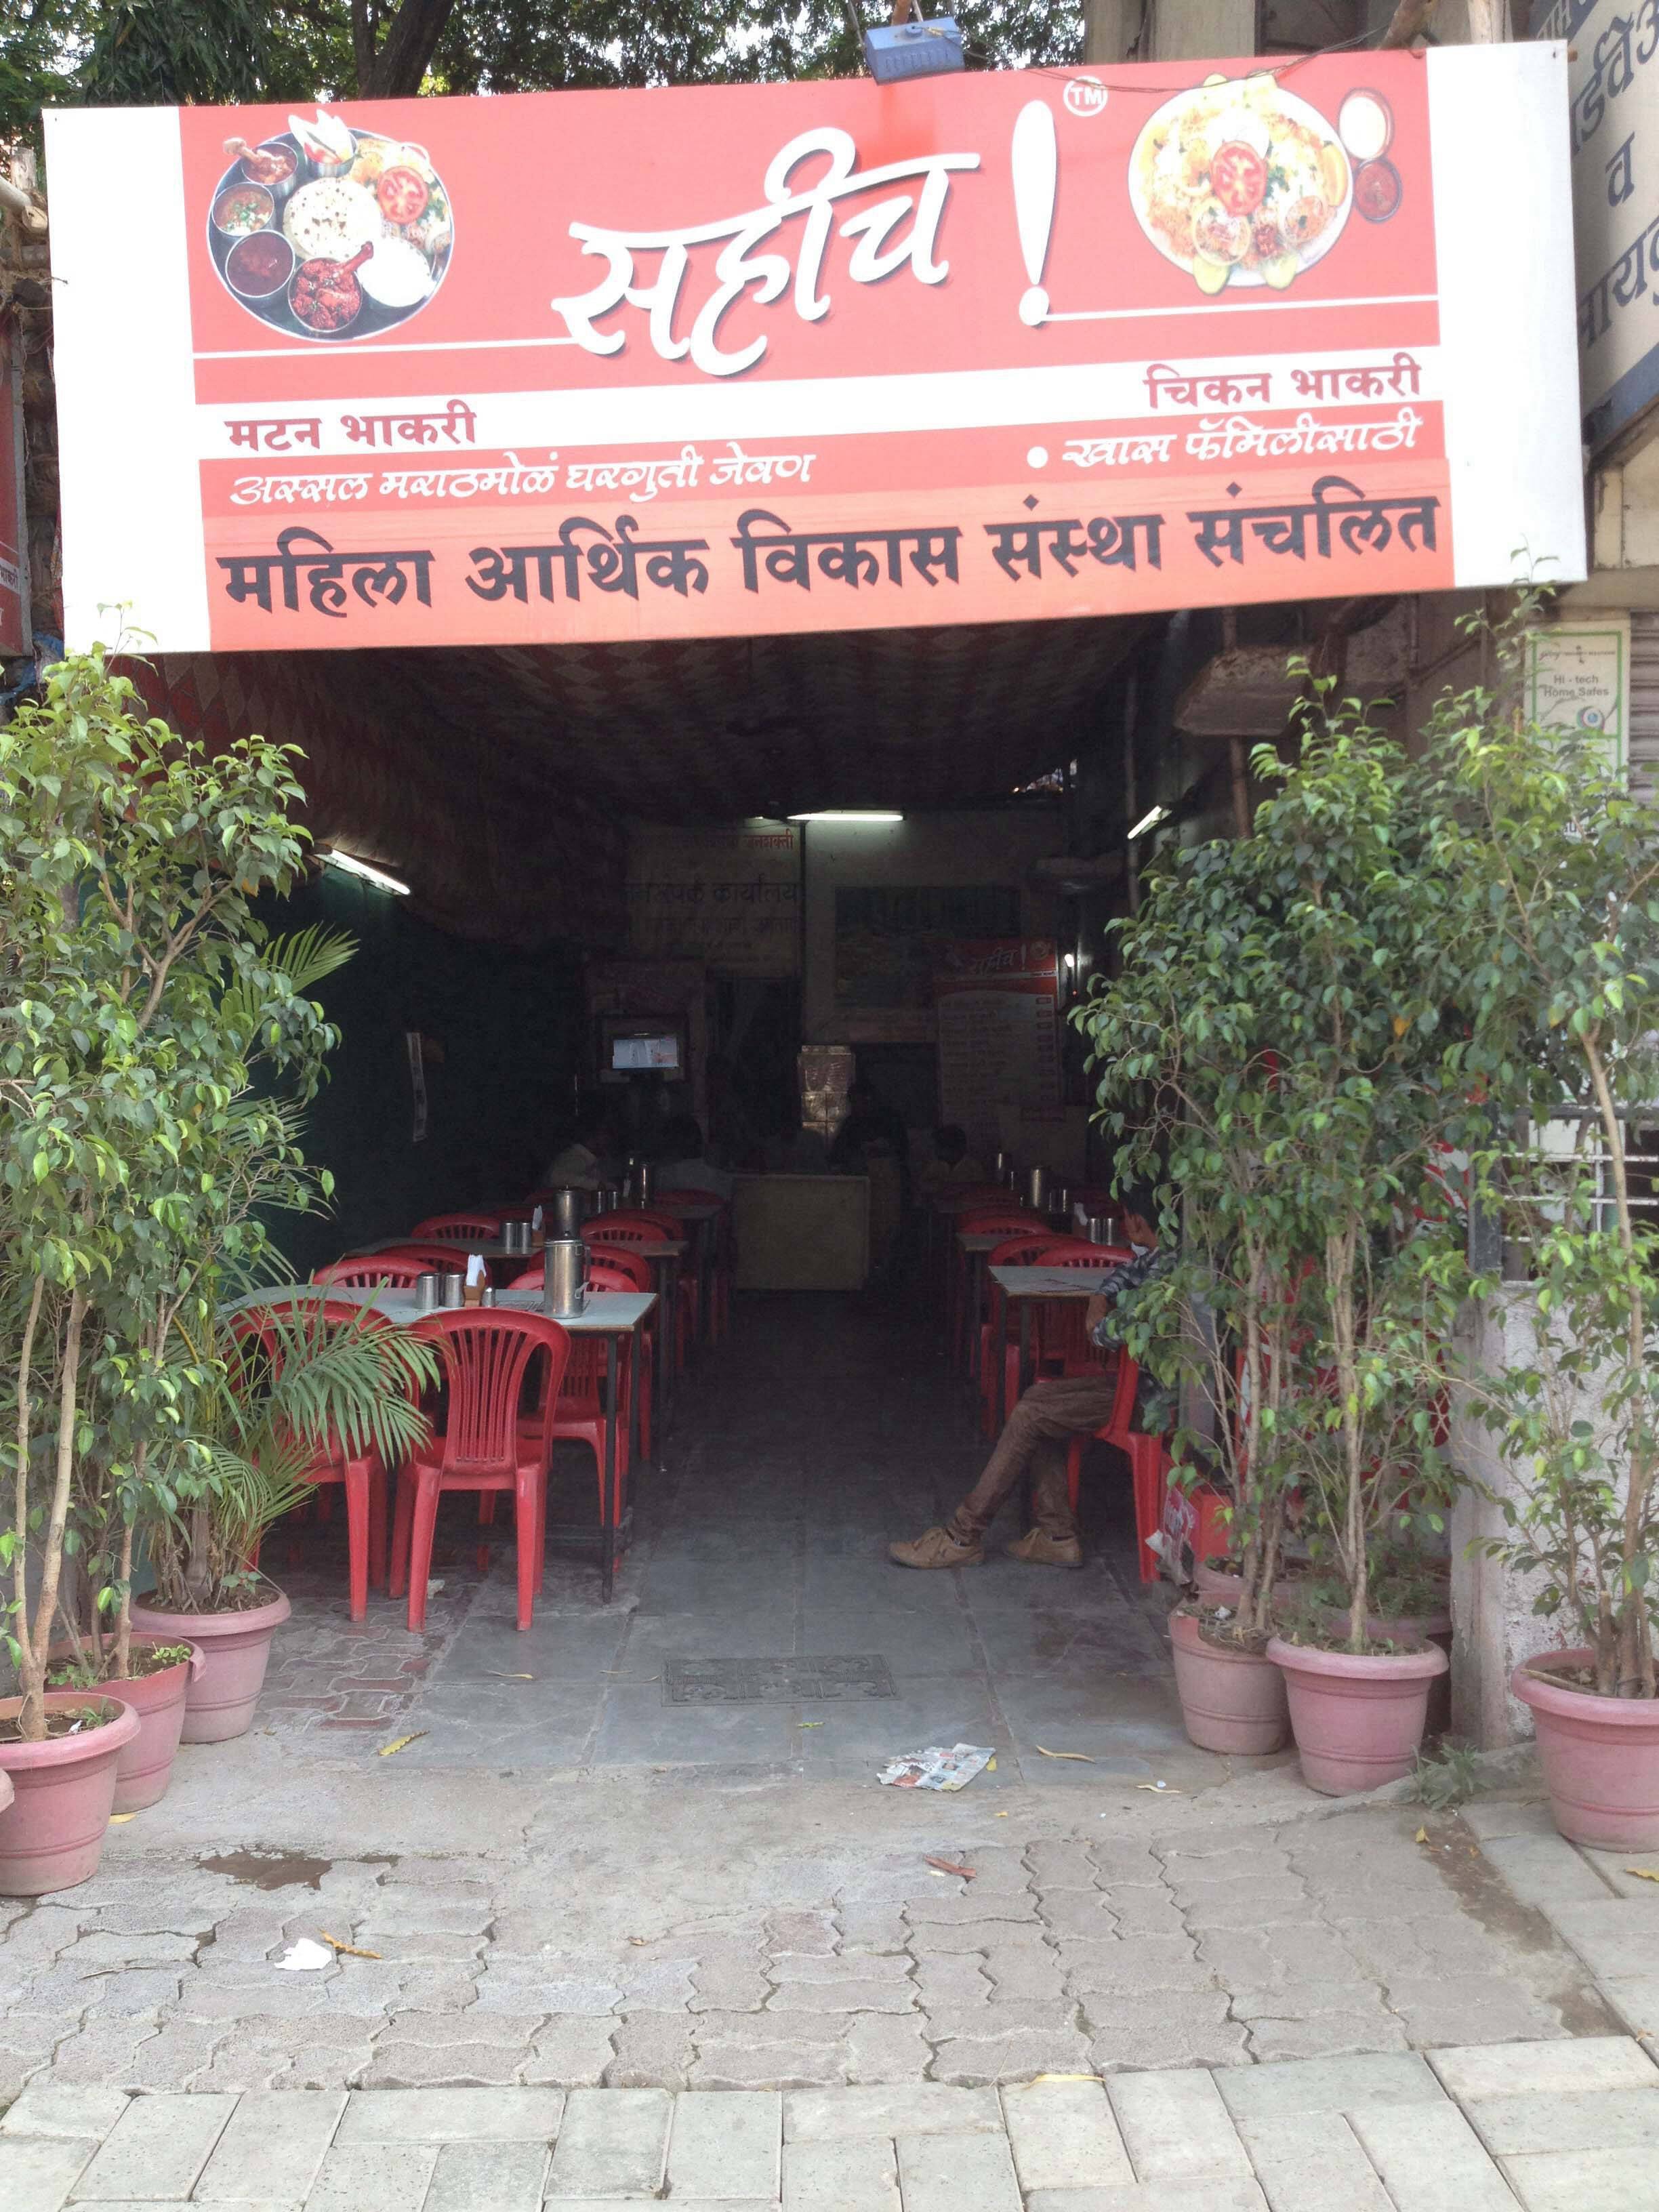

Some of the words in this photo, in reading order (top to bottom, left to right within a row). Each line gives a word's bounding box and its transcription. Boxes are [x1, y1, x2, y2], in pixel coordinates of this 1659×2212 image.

[551, 127, 982, 377] सहीच
[1143, 363, 1273, 409] चिकन
[1290, 352, 1422, 396] भाकरी
[224, 417, 322, 452] मटन
[340, 398, 477, 445] भाकरी
[1062, 434, 1178, 468] खास
[1185, 407, 1424, 461] फॅमिलीसाठी
[230, 472, 373, 504] अस्सल
[380, 451, 558, 499] मराठमोळं
[567, 445, 704, 502] घरगुती
[710, 441, 816, 485] जेवण
[216, 526, 436, 619] महिला
[465, 514, 710, 609] आर्थिक
[729, 509, 962, 594] विकास
[984, 494, 1166, 582] संस्था
[1186, 474, 1440, 568] संचलित
